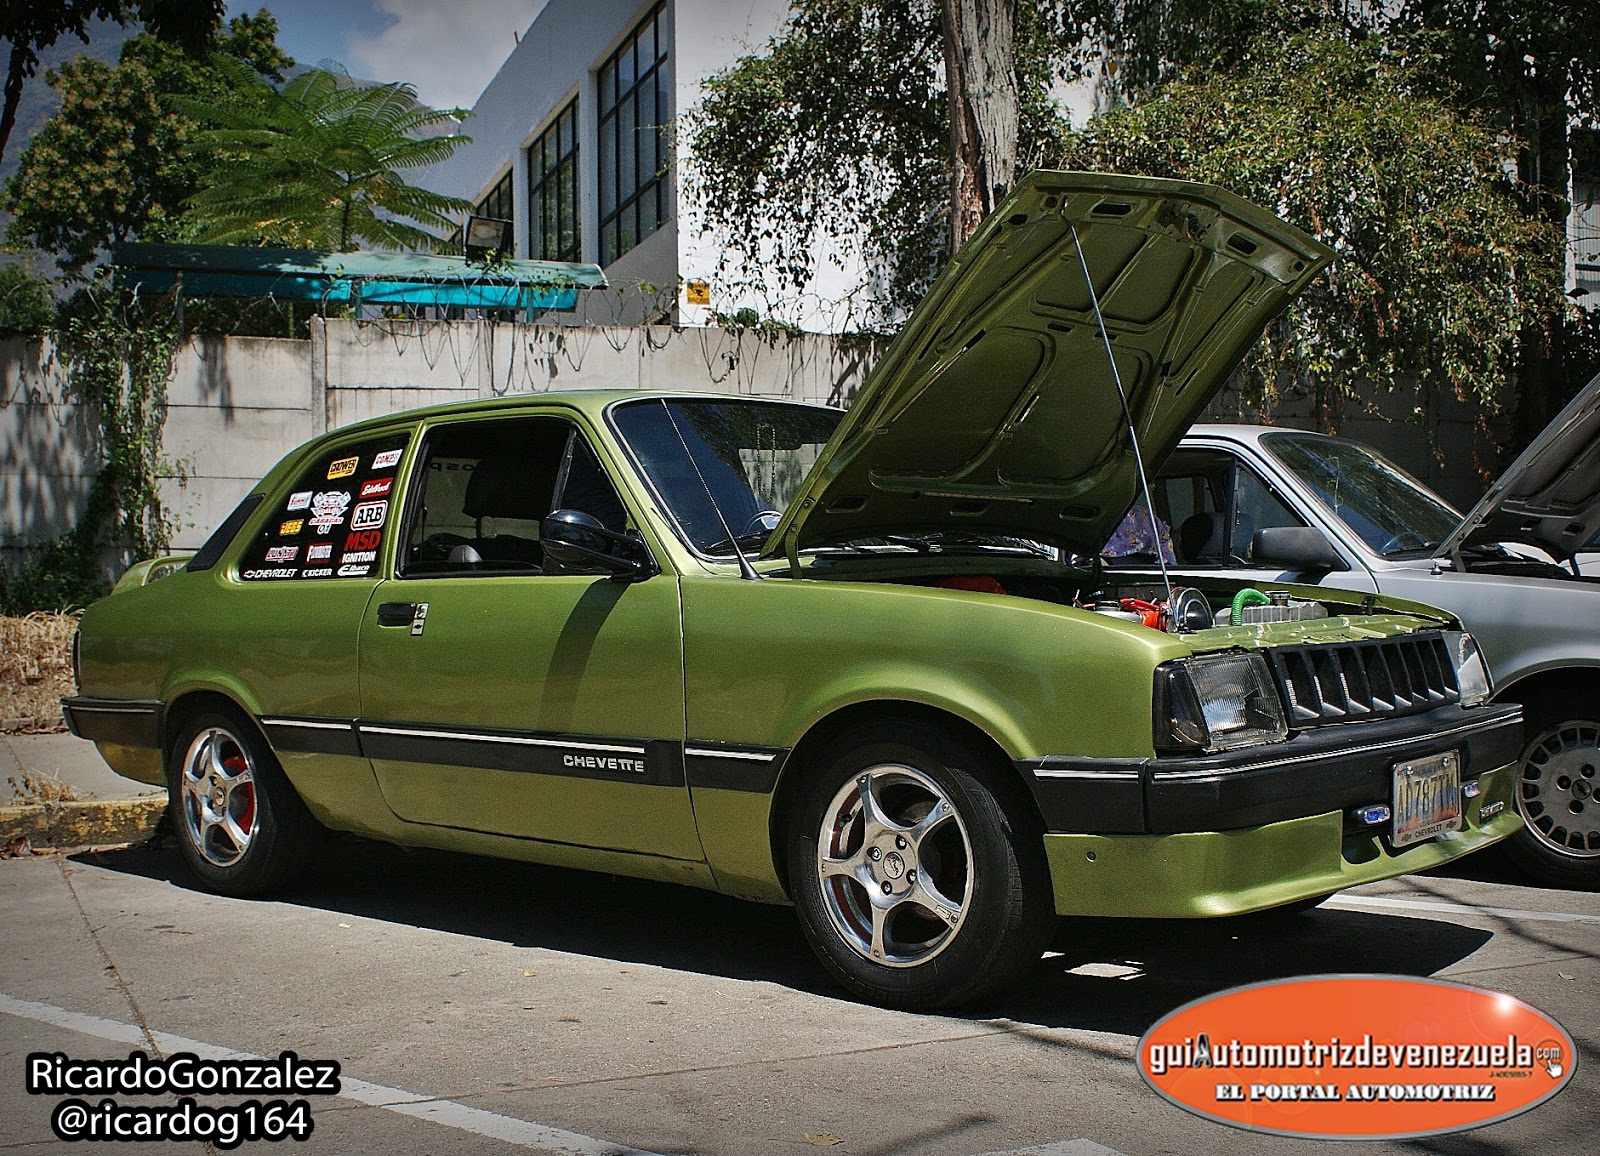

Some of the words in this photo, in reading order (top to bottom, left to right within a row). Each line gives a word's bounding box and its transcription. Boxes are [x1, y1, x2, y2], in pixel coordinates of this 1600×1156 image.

[356, 506, 383, 524] ARB
[344, 530, 382, 551] MSD
[341, 551, 377, 564] IGNITION
[254, 568, 298, 578] CHEVROLET
[307, 568, 333, 577] KICKER
[563, 755, 644, 772] CHEVETTE
[1414, 823, 1442, 838] CHEVROLET
